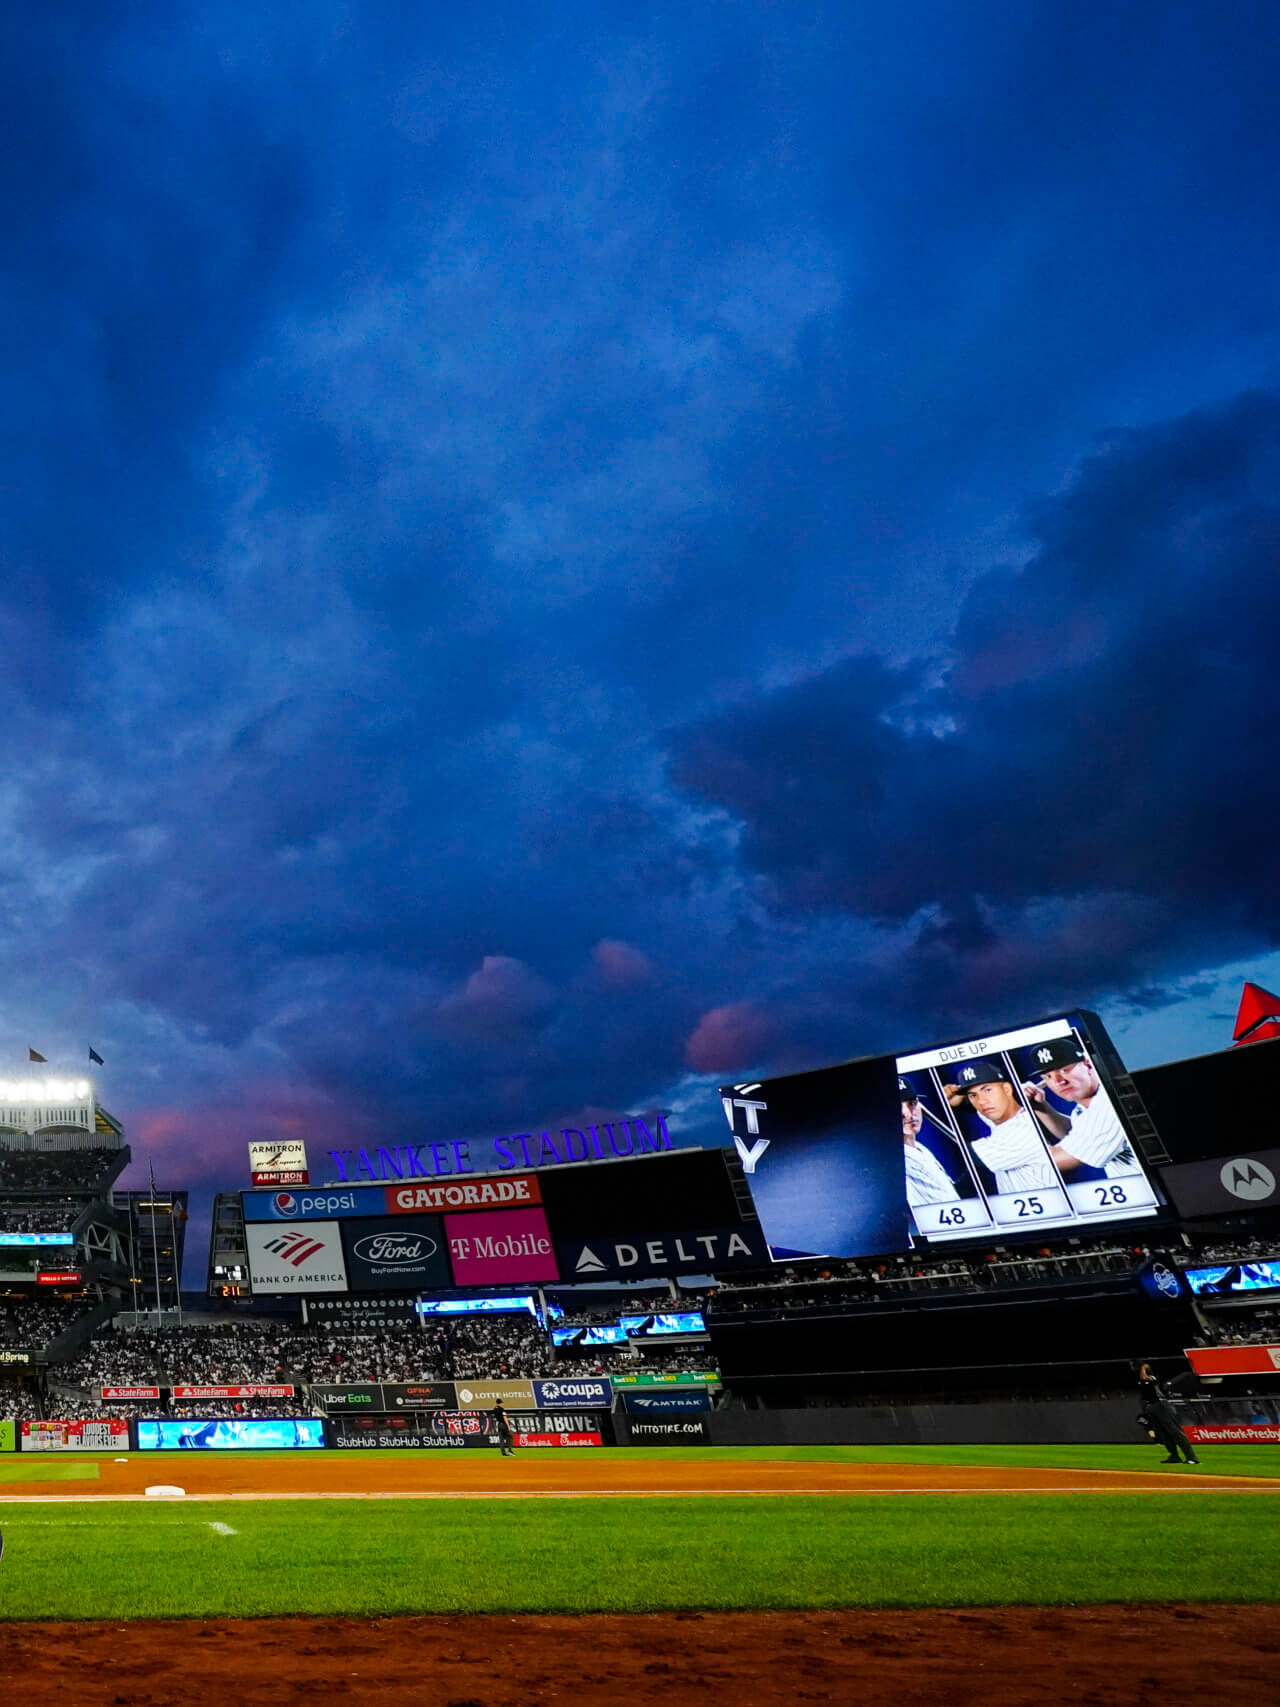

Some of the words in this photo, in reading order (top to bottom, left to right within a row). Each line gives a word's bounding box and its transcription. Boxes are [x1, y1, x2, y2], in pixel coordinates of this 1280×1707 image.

[939, 1048, 967, 1063] DUE
[968, 1042, 988, 1057] UP
[252, 1144, 302, 1153] ARMITRON
[328, 1140, 474, 1182] YANKEE
[493, 1115, 676, 1171] STADIUM
[257, 1172, 303, 1181] ARMITRON
[396, 1180, 531, 1209] GATORADE
[1094, 1185, 1127, 1206] 28
[301, 1193, 355, 1213] pepsi
[1013, 1196, 1044, 1217] 25
[938, 1207, 966, 1226] 48
[368, 1236, 422, 1259] Ford
[615, 1232, 752, 1267] DELTA
[371, 1265, 426, 1275] BuyFordNow.com
[252, 1276, 279, 1284] BANK
[282, 1275, 294, 1283] OF
[297, 1274, 345, 1282] AMERICA
[6, 1353, 29, 1363] Spring
[323, 1394, 347, 1403] Uber
[348, 1393, 372, 1403] Eats
[474, 1392, 501, 1400] LOTTE
[502, 1391, 532, 1399] HOTELS
[560, 1383, 604, 1399] coupa
[631, 1422, 703, 1435] NITTOTIRE.COM
[336, 1437, 376, 1447] StubHub
[379, 1436, 420, 1447] StubHub
[423, 1436, 465, 1446] StubHub
